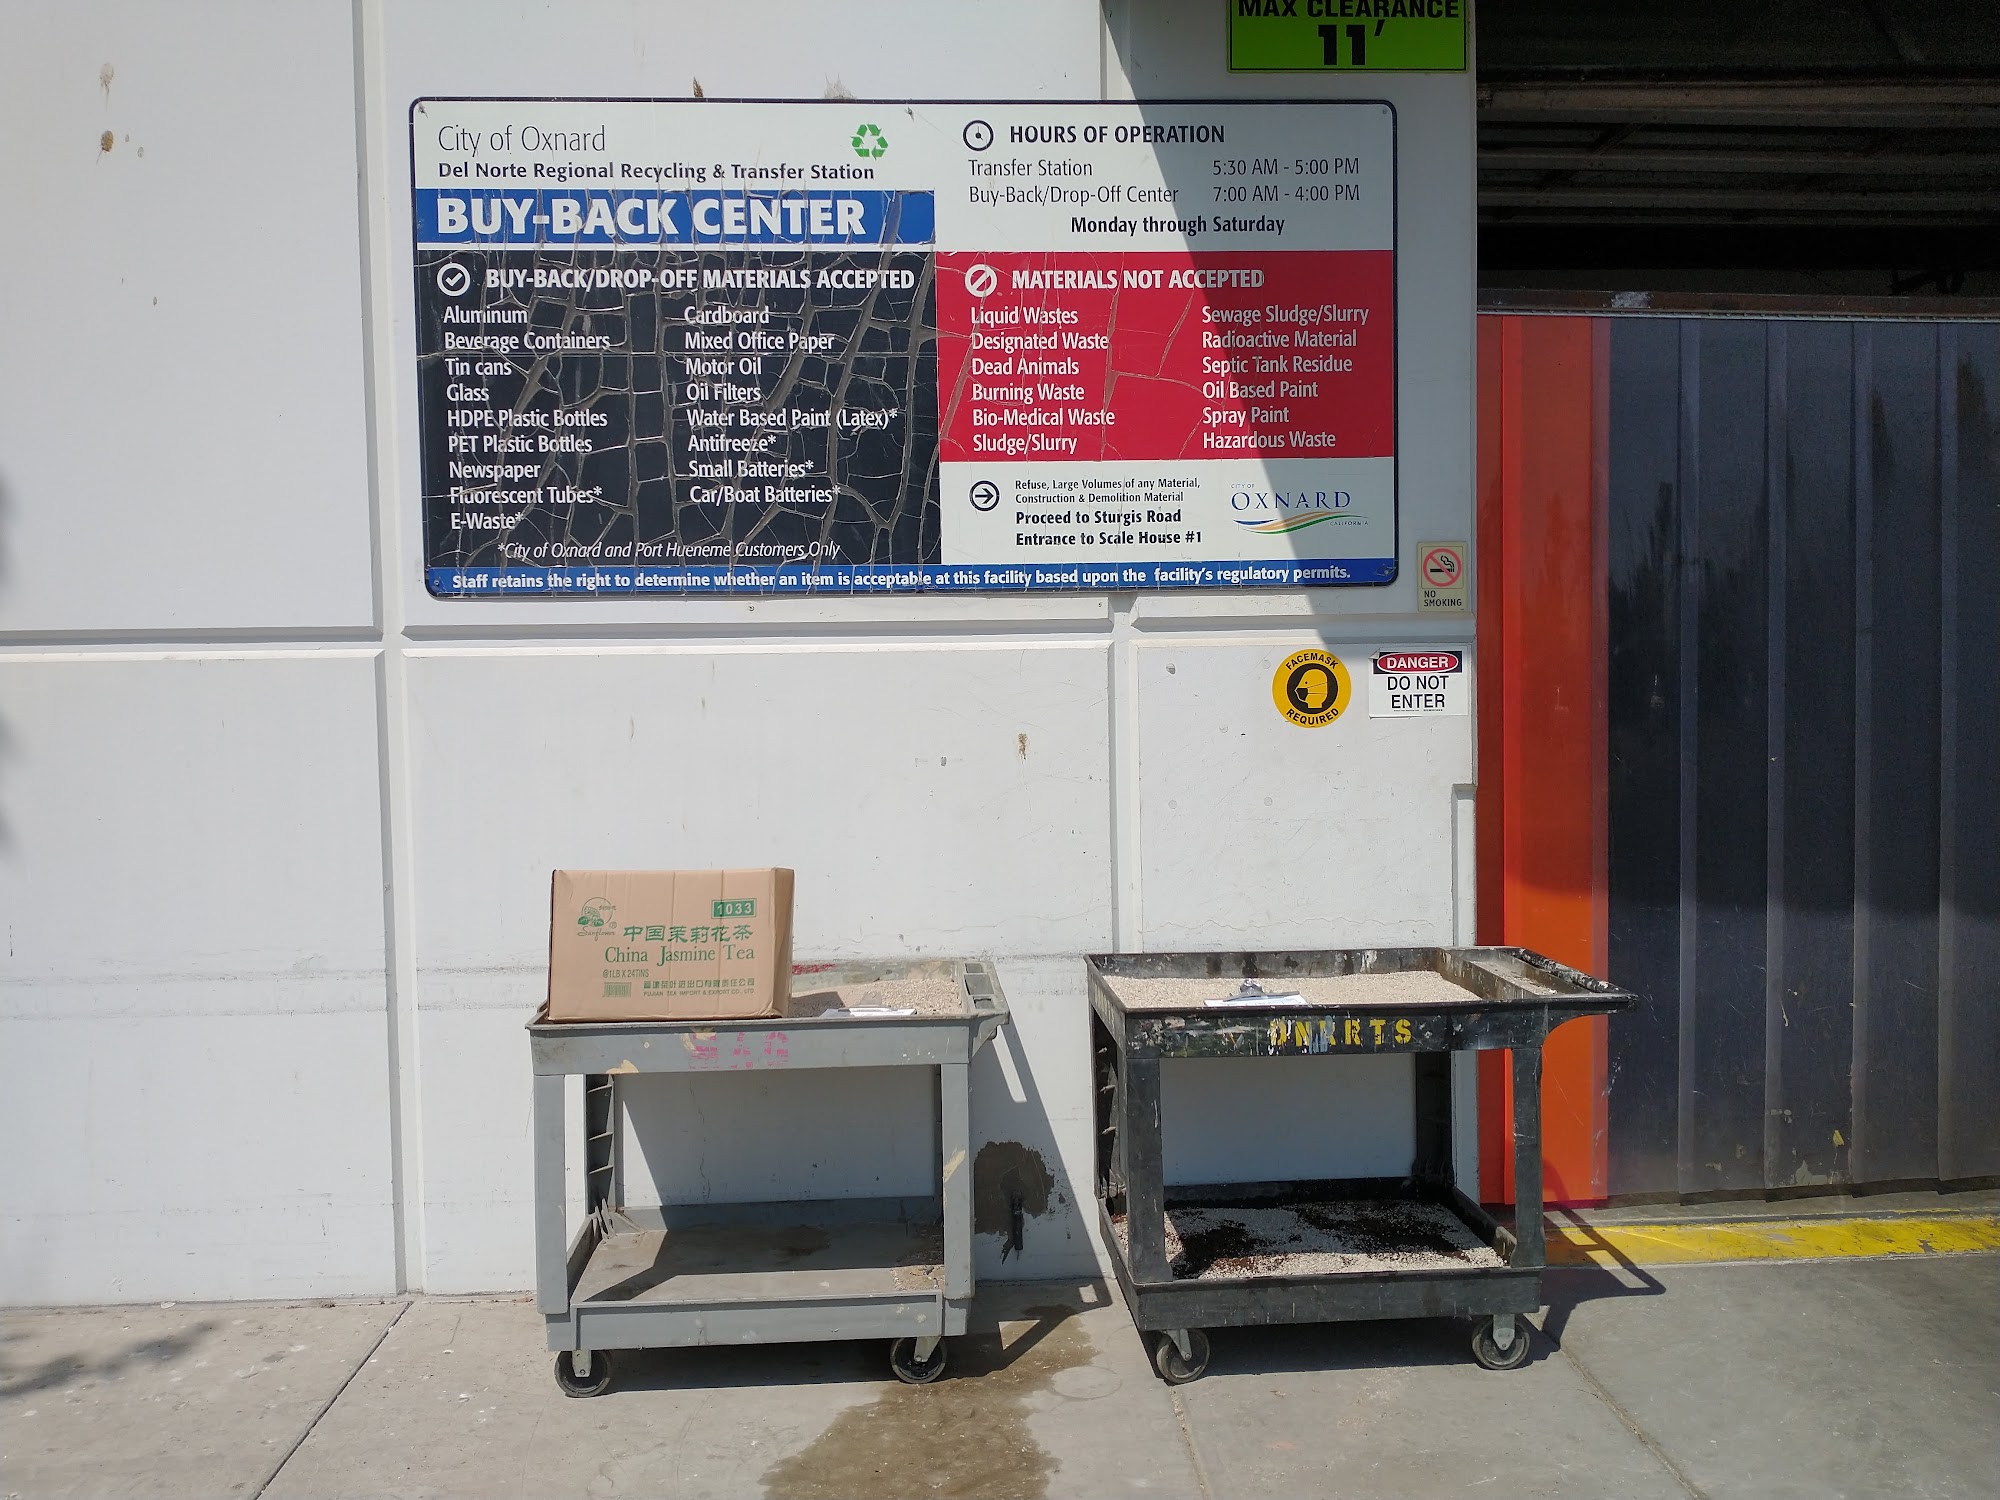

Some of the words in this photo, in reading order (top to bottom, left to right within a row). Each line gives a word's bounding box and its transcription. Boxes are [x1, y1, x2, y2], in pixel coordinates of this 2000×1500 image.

[439, 124, 481, 156] City
[521, 124, 606, 152] Oxnard
[1010, 126, 1077, 144] HOURS
[1084, 126, 1108, 144] OF
[1114, 125, 1225, 143] OPERATION
[439, 162, 470, 179] Del
[476, 162, 527, 179] Norte
[534, 162, 614, 182] Regional
[621, 162, 707, 183] Recycling
[731, 163, 806, 180] Transfer
[810, 164, 875, 180] Station
[968, 158, 1033, 177] Transfer
[1038, 158, 1093, 176] Station
[1212, 158, 1247, 176] 5:30
[1252, 158, 1279, 175] AM
[1294, 158, 1329, 175] 5:00
[1335, 158, 1360, 175] PM
[968, 185, 1122, 207] Buy-Back/Drop-Off
[1127, 186, 1179, 204] Center
[1214, 186, 1247, 203] 7:00
[1252, 185, 1279, 202] AM
[1294, 184, 1329, 202] 4:00
[1335, 184, 1360, 201] PM
[438, 198, 681, 235] BUY-BACK
[694, 198, 867, 236] CENTER
[1071, 216, 1138, 237] Monday
[1143, 216, 1207, 236] through
[1213, 216, 1285, 236] Saturday
[486, 268, 697, 291] BUY-BACK/DROP-OFF
[703, 268, 812, 289] MATERIALS
[816, 268, 915, 289] ACCEPTED
[1012, 269, 1118, 289] MATERIALS
[1123, 269, 1163, 289] NOT
[1169, 268, 1265, 289] ACCEPTED
[443, 306, 528, 324] Aluminum
[684, 306, 770, 324] Cardboard
[971, 306, 1020, 327] Liquid
[1023, 307, 1078, 325] Wastes
[1202, 306, 1261, 326] Sewage
[1265, 304, 1369, 325] Sludge/Slurry
[444, 332, 519, 353] Beverage
[524, 331, 610, 350] Containers
[685, 331, 734, 350] Mixed
[738, 331, 785, 350] Office
[788, 332, 835, 354] Paper
[972, 332, 1059, 352] Designated
[1064, 333, 1110, 350] Waste
[1202, 330, 1290, 349] Radioactive
[1294, 330, 1357, 348] Material
[445, 358, 470, 376] Tin
[475, 361, 512, 376] cans
[685, 358, 735, 375] Motor
[739, 357, 762, 375] Oil
[972, 358, 1015, 376] Dead
[1018, 358, 1079, 376] Animals
[1202, 356, 1250, 377] Septic
[1254, 356, 1289, 373] Tank
[1293, 355, 1353, 373] Residue
[446, 384, 490, 402] Glass
[686, 383, 710, 400] Oil
[714, 383, 761, 401] Filters
[972, 384, 1034, 404] Burning
[1037, 384, 1085, 402] Waste
[1202, 381, 1227, 399] Oil
[1229, 381, 1277, 399] Based
[1280, 380, 1319, 398] Paint
[447, 410, 494, 427] HDPE
[498, 409, 550, 427] Plastic
[554, 409, 608, 427] Bottles
[687, 409, 735, 427] Water
[740, 408, 787, 427] Based
[792, 408, 832, 427] Paint
[973, 408, 1064, 427] Bio-Medical
[1068, 410, 1116, 426] Waste
[1202, 408, 1247, 428] Spray
[1251, 406, 1290, 424] Paint
[448, 436, 478, 453] PET
[484, 435, 534, 453] Plastic
[538, 435, 593, 453] Bottles
[973, 434, 1078, 455] Sludge/Slurry
[1202, 430, 1286, 449] Hazardous
[1290, 430, 1337, 448] Waste
[449, 462, 541, 483] Newspaper
[689, 460, 732, 478] Small
[1015, 480, 1050, 491] Refuse,
[1053, 479, 1080, 492] Large
[1082, 478, 1122, 490] Volumes
[1158, 477, 1201, 490] Material,
[450, 486, 544, 504] Fluorescent
[690, 484, 760, 506] Car/Boat
[1015, 493, 1076, 504] Construction
[1088, 492, 1142, 504] Demolition
[1144, 492, 1184, 502] Material
[1231, 491, 1351, 511] OXNARD
[1016, 510, 1072, 524] Proceed
[1094, 510, 1142, 527] Sturgis
[1146, 509, 1182, 523] Road
[1016, 532, 1076, 546] Entrance
[1099, 531, 1135, 545] Scale
[1138, 530, 1181, 544] House
[1184, 530, 1202, 543] #1
[552, 542, 601, 558] Oxnard
[635, 542, 664, 558] Port
[667, 542, 731, 558] Hueneme
[735, 541, 806, 557] Customers
[809, 540, 840, 560] Only
[452, 574, 489, 588] Staff
[492, 574, 544, 588] retains
[576, 572, 611, 590] right
[634, 572, 710, 588] determine
[714, 572, 776, 588] whether
[802, 572, 834, 586] item
[854, 571, 932, 588] acceptable
[984, 570, 1032, 588] facility
[1036, 570, 1078, 584] based
[1082, 572, 1120, 586] upon
[1154, 567, 1213, 585] facility's
[1217, 566, 1289, 584] regulatory
[1293, 566, 1351, 582] permits.
[1424, 590, 1436, 598] NO
[1424, 598, 1462, 607] SMOKING
[1286, 652, 1339, 670] FACEMASK
[1386, 656, 1449, 670] DANGER
[1387, 676, 1411, 691] DO
[1416, 675, 1450, 690] NOT
[1391, 694, 1446, 709] ENTER
[1286, 707, 1340, 726] REQUIRED
[717, 902, 752, 914] 1033
[623, 924, 754, 944] 中国茉莉花茶
[605, 946, 648, 964] China
[657, 944, 716, 966] Jasmine
[723, 944, 756, 960] Tea
